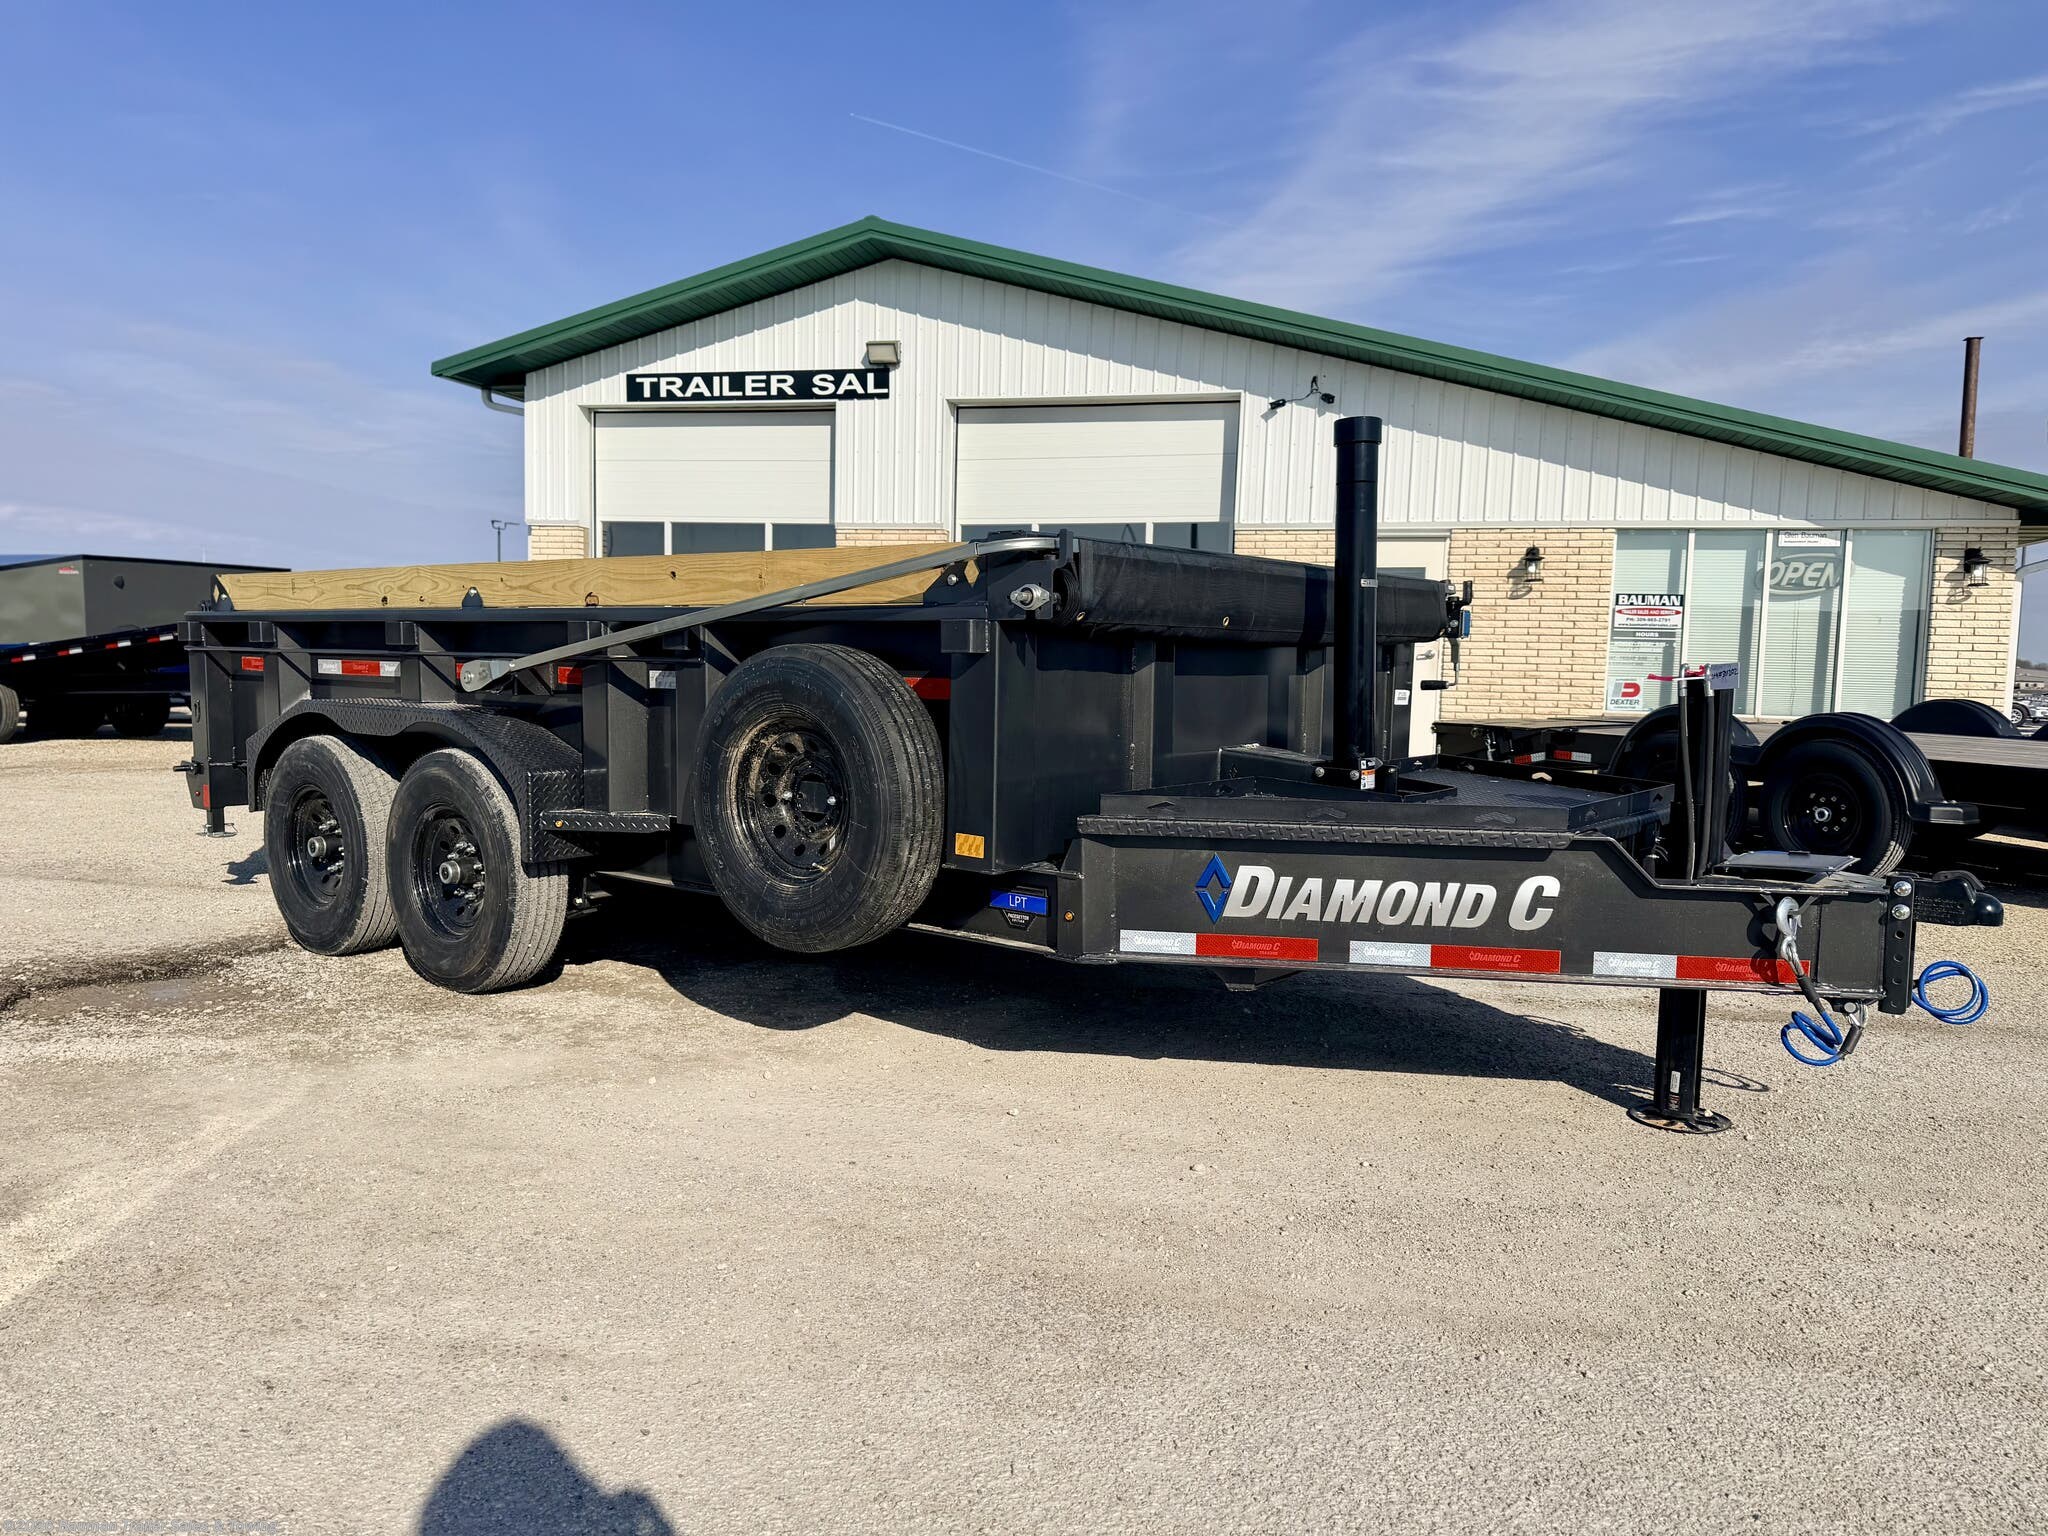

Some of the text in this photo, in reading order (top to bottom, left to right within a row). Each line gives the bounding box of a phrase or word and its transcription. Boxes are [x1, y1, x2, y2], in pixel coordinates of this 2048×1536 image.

[636, 372, 889, 398] TRAILER SAL
[1770, 561, 1840, 588] OPEN
[1618, 594, 1681, 606] BAUMAN
[1610, 698, 1640, 706] DEXTER
[1009, 894, 1028, 909] LPT
[1222, 865, 1562, 931] DIAMOND C
[1236, 940, 1281, 951] DIAMOND C
[1473, 952, 1521, 963] DIAMOND C
